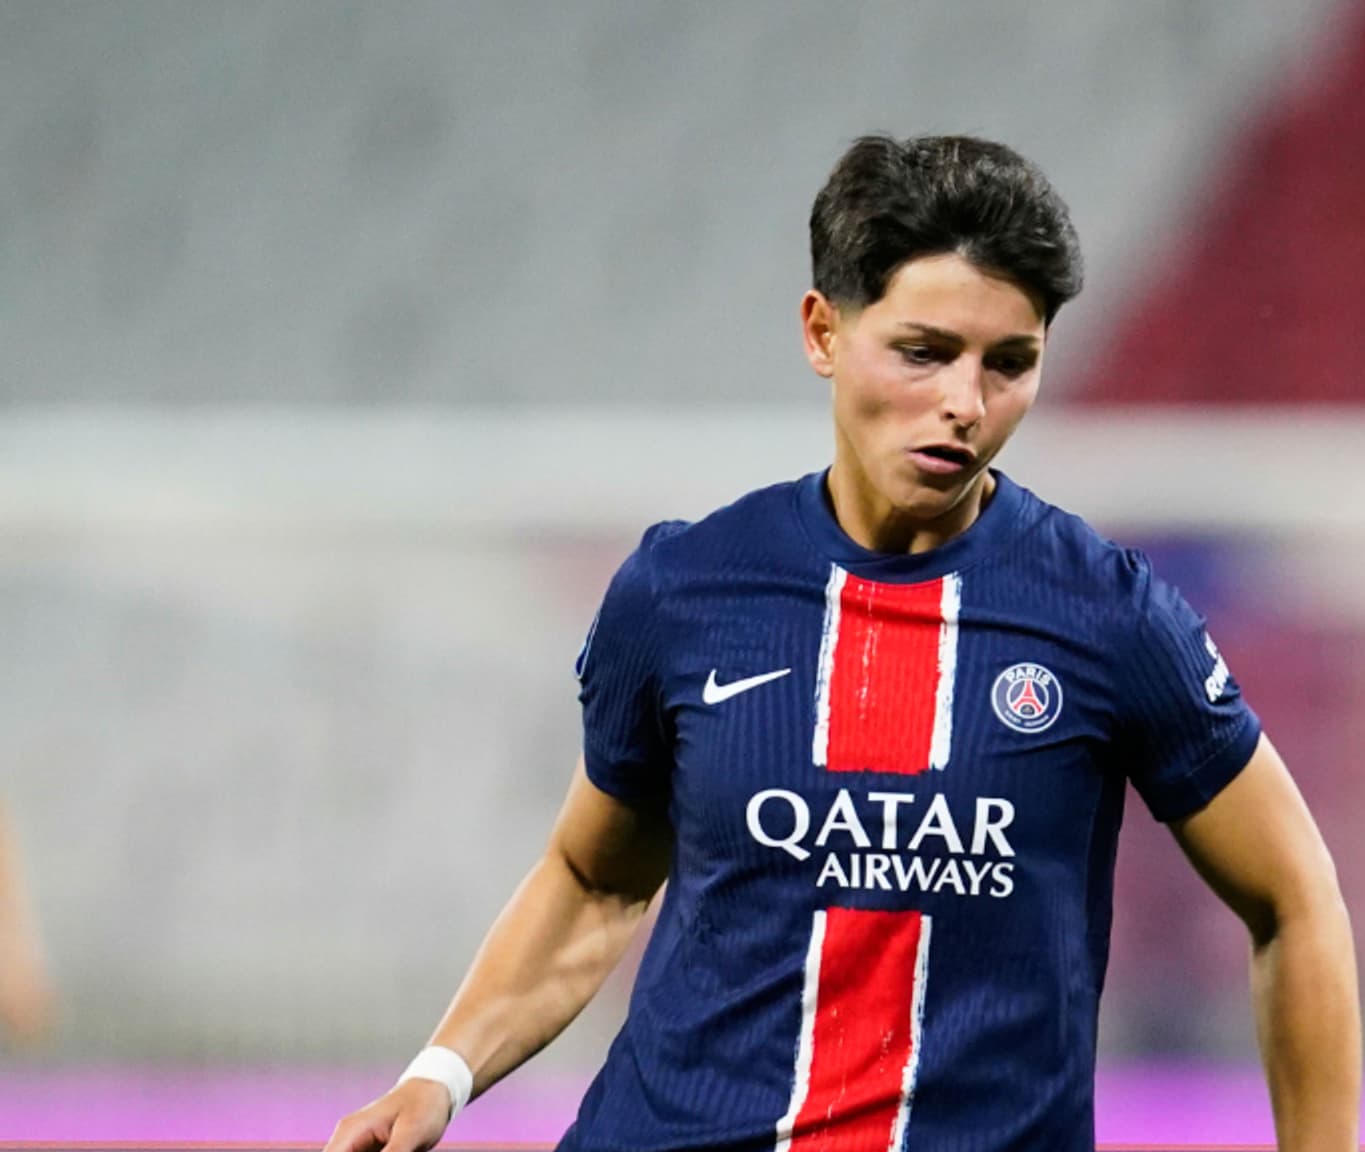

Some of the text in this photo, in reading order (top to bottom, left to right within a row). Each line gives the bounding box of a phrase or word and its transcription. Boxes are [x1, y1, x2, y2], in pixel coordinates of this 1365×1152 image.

[1005, 666, 1053, 686] PARIS
[746, 788, 1016, 862] QATAR
[816, 852, 1014, 898] AIRWAYS
